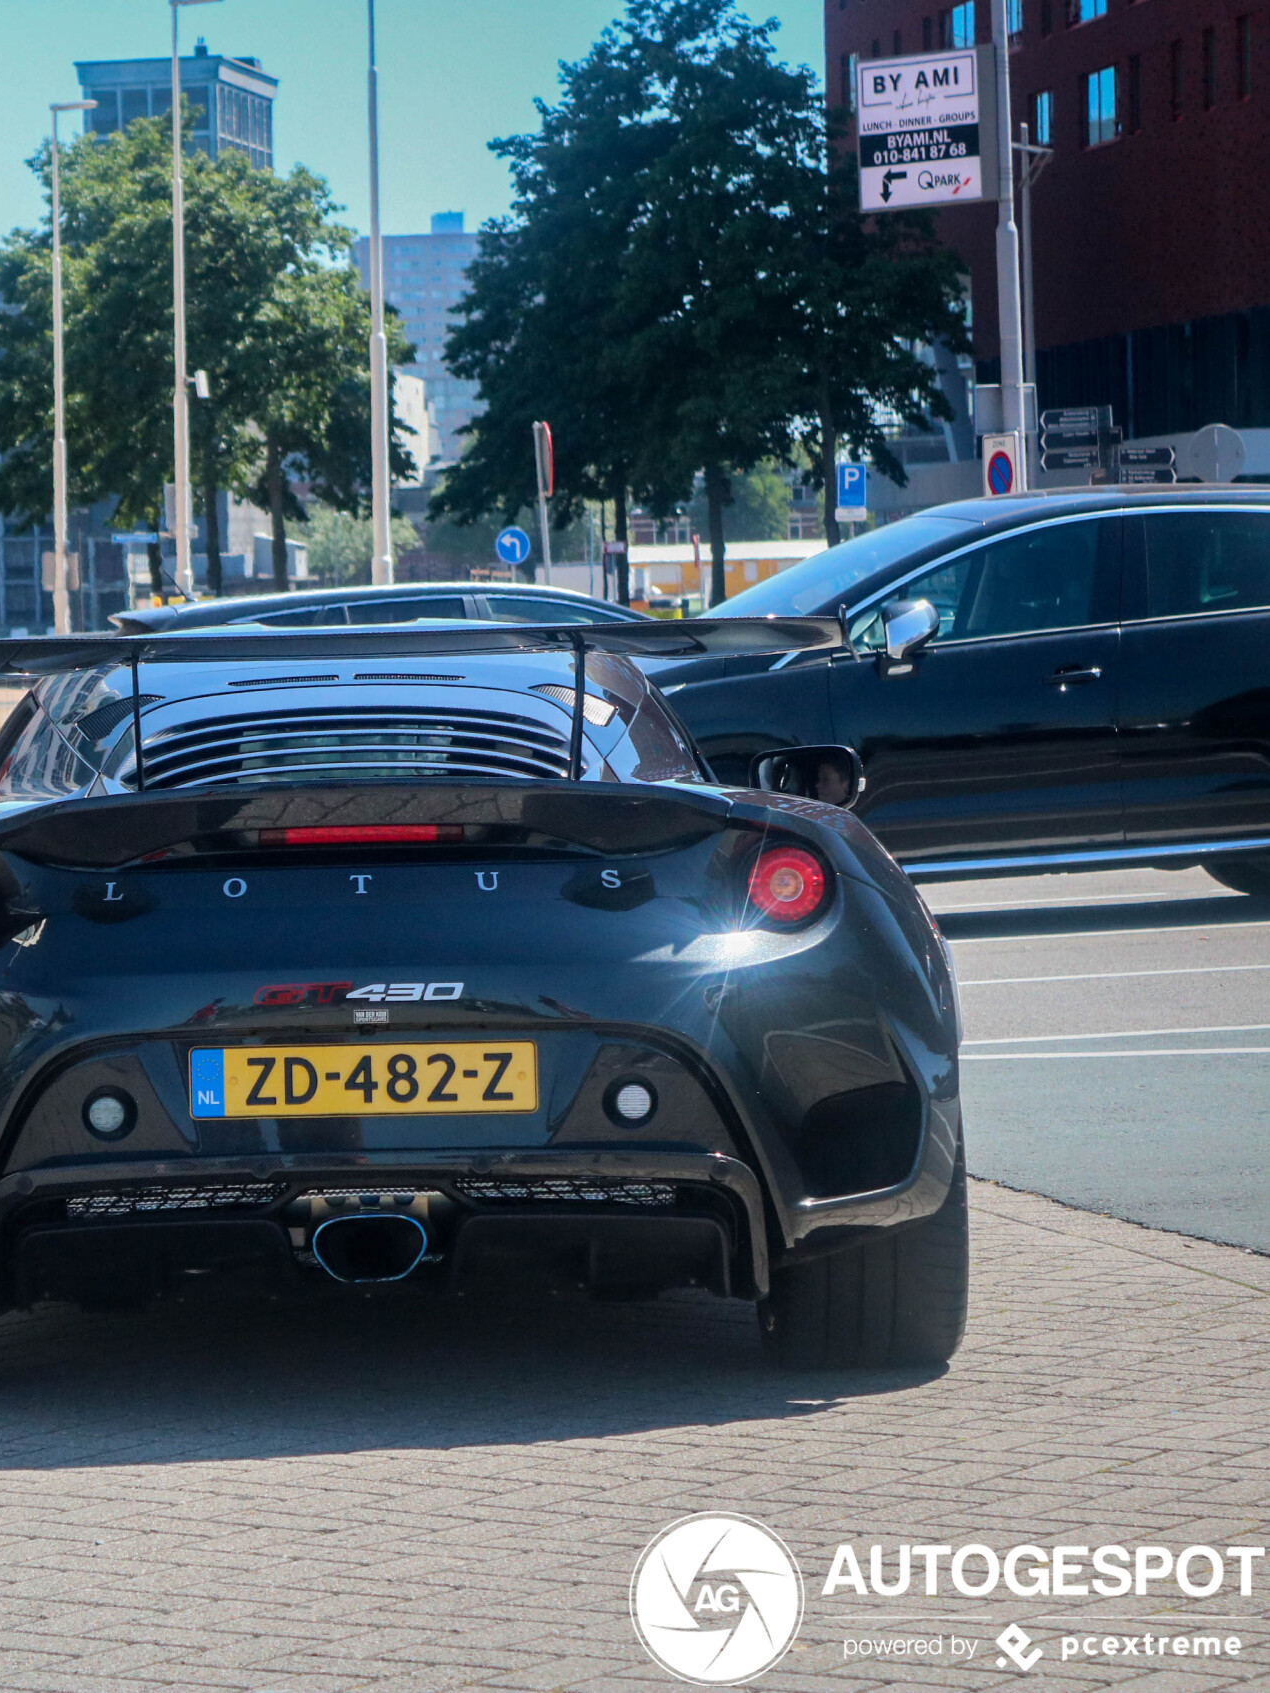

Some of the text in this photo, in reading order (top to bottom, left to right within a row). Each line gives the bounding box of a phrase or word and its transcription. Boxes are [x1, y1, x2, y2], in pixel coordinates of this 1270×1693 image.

[873, 65, 959, 94] BY AMI
[862, 111, 976, 132] LUNCH DINNER GROUPS
[886, 129, 952, 149] BYAMI.NL
[873, 142, 967, 165] 010-841 87 68
[844, 467, 860, 490] P
[103, 869, 623, 902] LOTUS
[345, 981, 465, 1002] 430
[196, 1052, 516, 1106] NL ZD-482-Z
